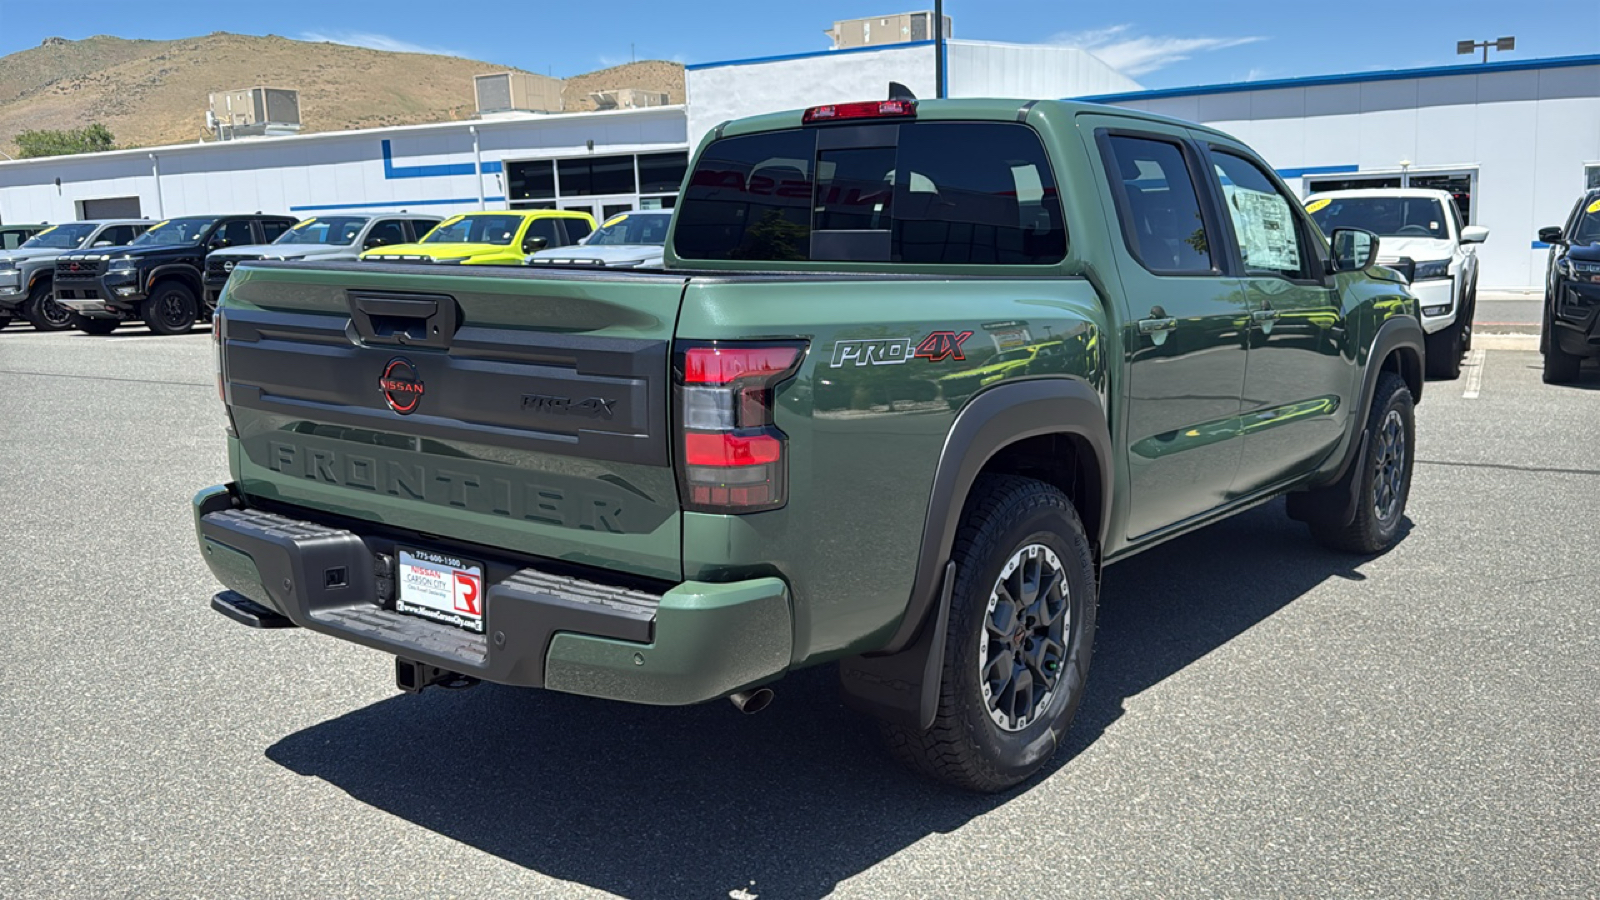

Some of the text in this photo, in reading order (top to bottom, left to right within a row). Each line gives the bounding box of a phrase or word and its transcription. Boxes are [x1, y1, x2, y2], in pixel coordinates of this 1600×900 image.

[830, 331, 974, 368] PRO-4X
[380, 379, 423, 393] NISSAN
[268, 440, 626, 534] FRONTIER
[407, 574, 446, 590] CARSON CITY
[411, 565, 440, 579] NISSAN
[455, 575, 477, 614] R
